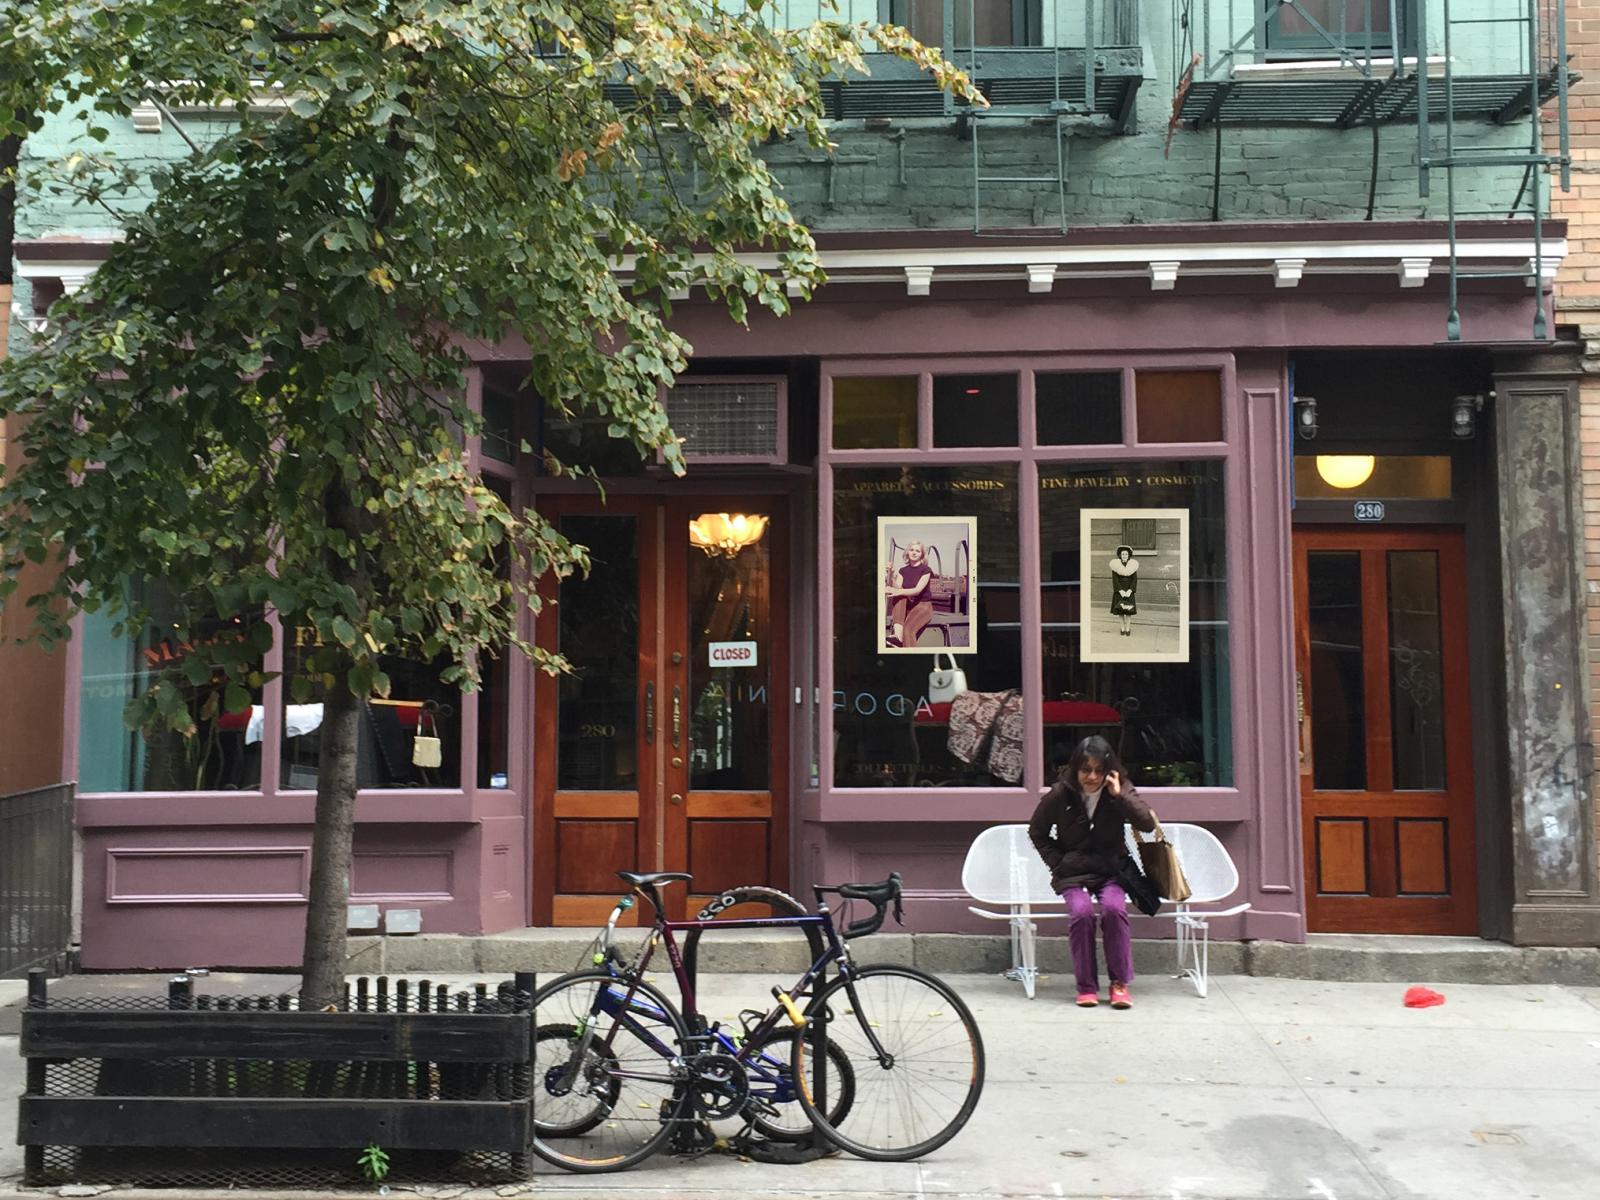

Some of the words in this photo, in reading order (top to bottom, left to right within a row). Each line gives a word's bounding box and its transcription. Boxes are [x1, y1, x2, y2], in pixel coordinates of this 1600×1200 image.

[1041, 477, 1071, 489] FINE
[1073, 476, 1130, 488] JEWELRY
[1358, 504, 1381, 518] 280
[713, 647, 751, 660] CLOSED
[579, 724, 616, 738] 280
